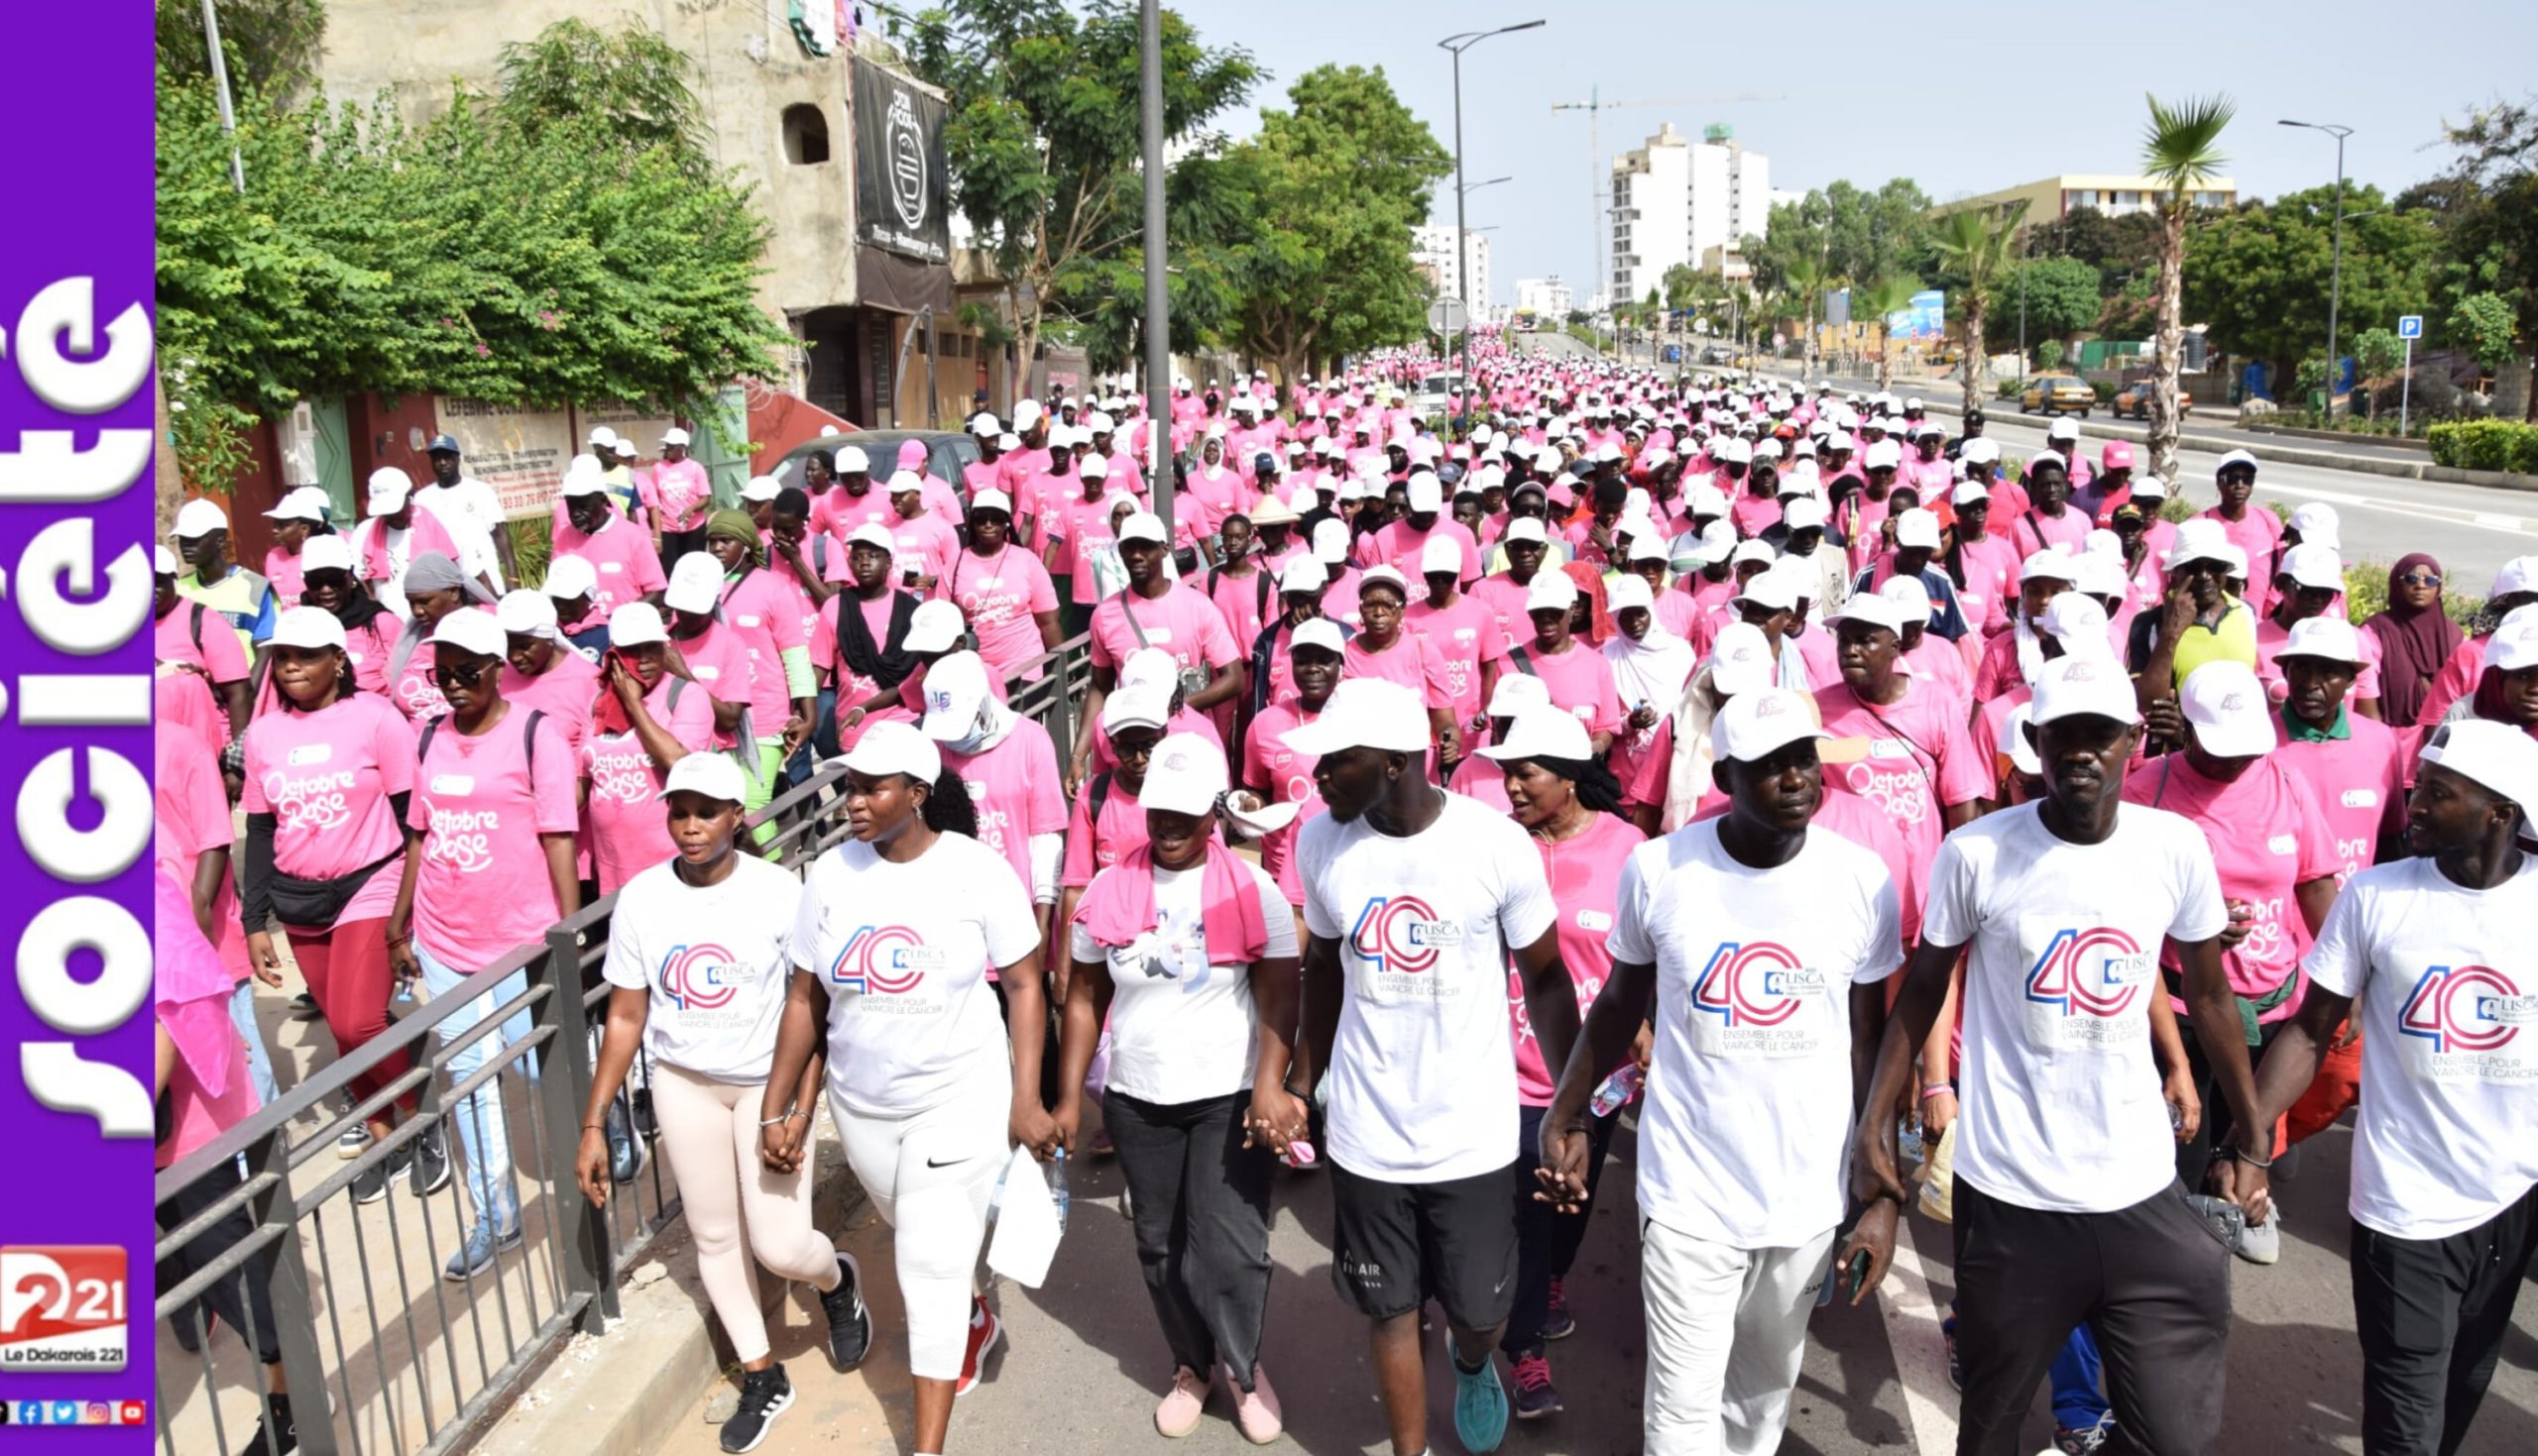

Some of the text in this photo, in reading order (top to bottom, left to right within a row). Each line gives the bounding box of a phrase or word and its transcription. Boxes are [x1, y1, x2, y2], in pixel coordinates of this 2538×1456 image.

[264, 770, 357, 804] Octobre
[279, 792, 350, 834] Rose
[1425, 924, 1460, 936] LISCA
[1786, 972, 1826, 984] LISCA
[1776, 1031, 1804, 1040] POUR
[1722, 1041, 1767, 1051] VAINCRE
[1769, 1042, 1778, 1052] LE
[2488, 1057, 2521, 1068] POUR
[2480, 1066, 2490, 1077] LE
